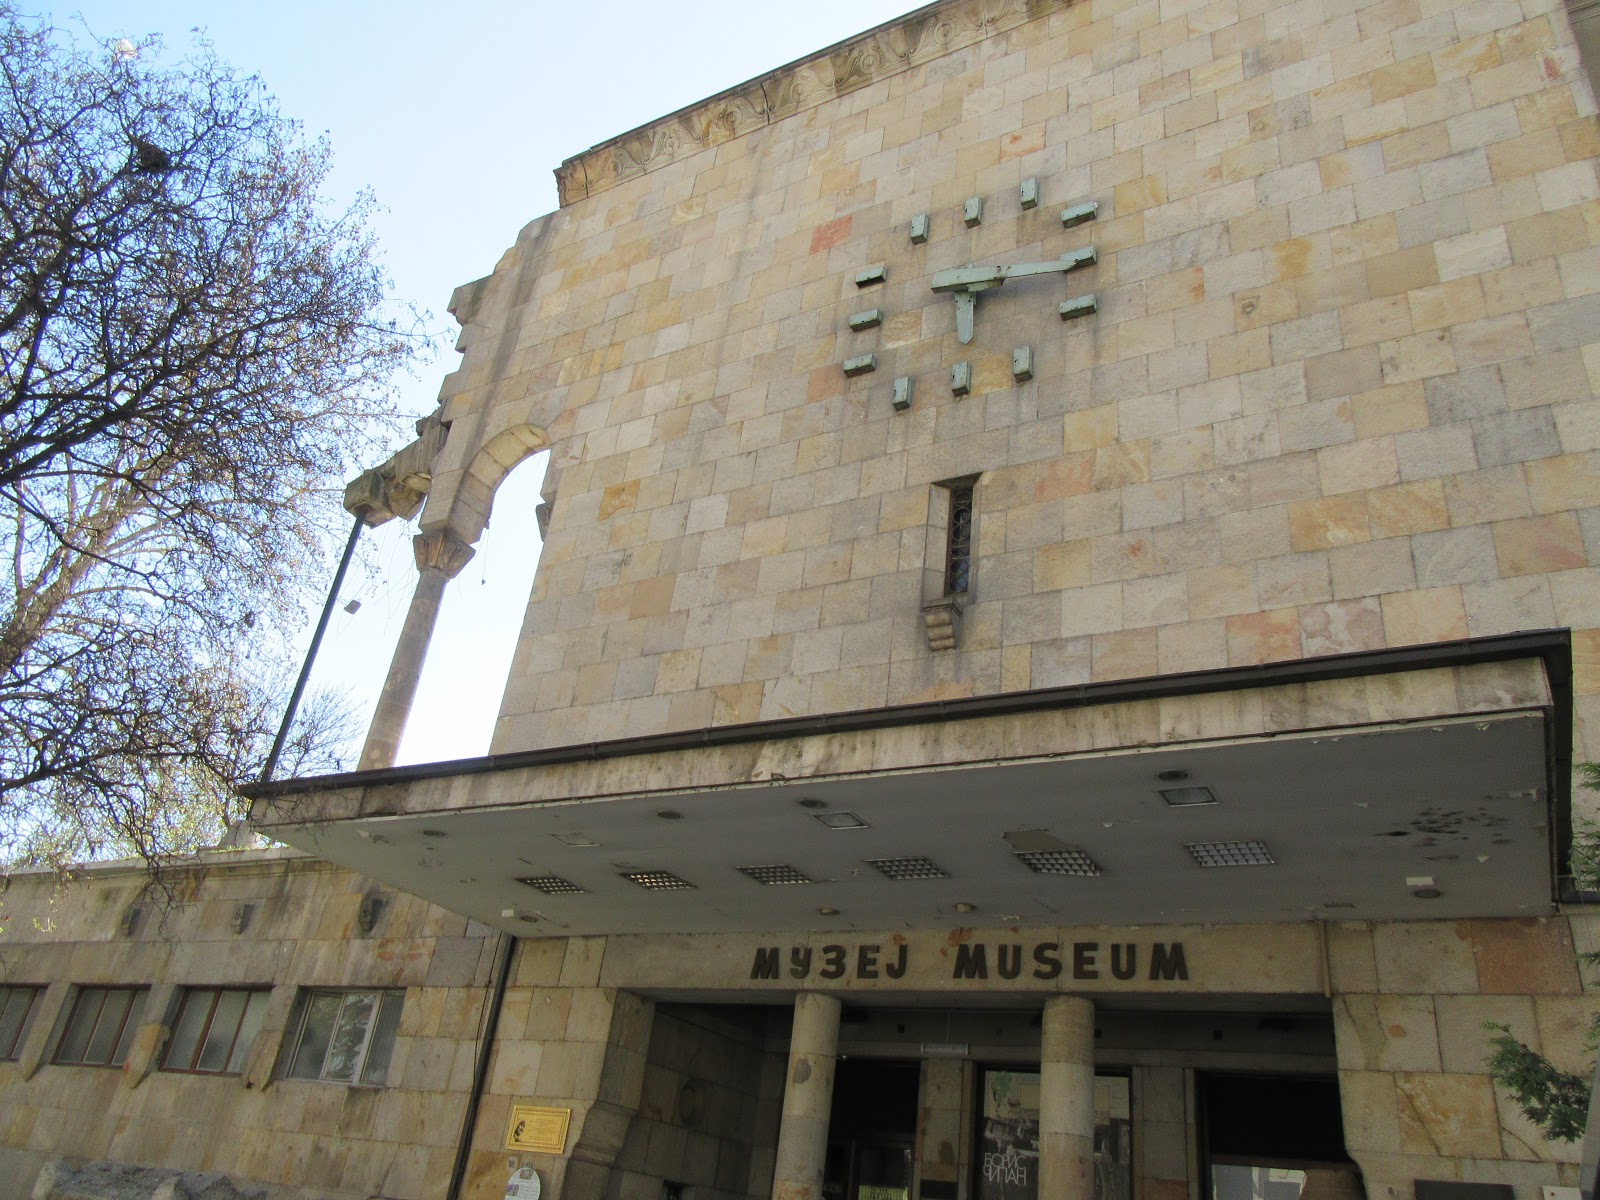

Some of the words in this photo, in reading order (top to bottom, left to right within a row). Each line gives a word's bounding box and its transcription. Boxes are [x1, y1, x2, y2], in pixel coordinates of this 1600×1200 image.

[751, 944, 908, 980] МУЗЕЈ
[953, 942, 1189, 981] MUSEUM
[984, 1152, 1026, 1170] БОРИС
